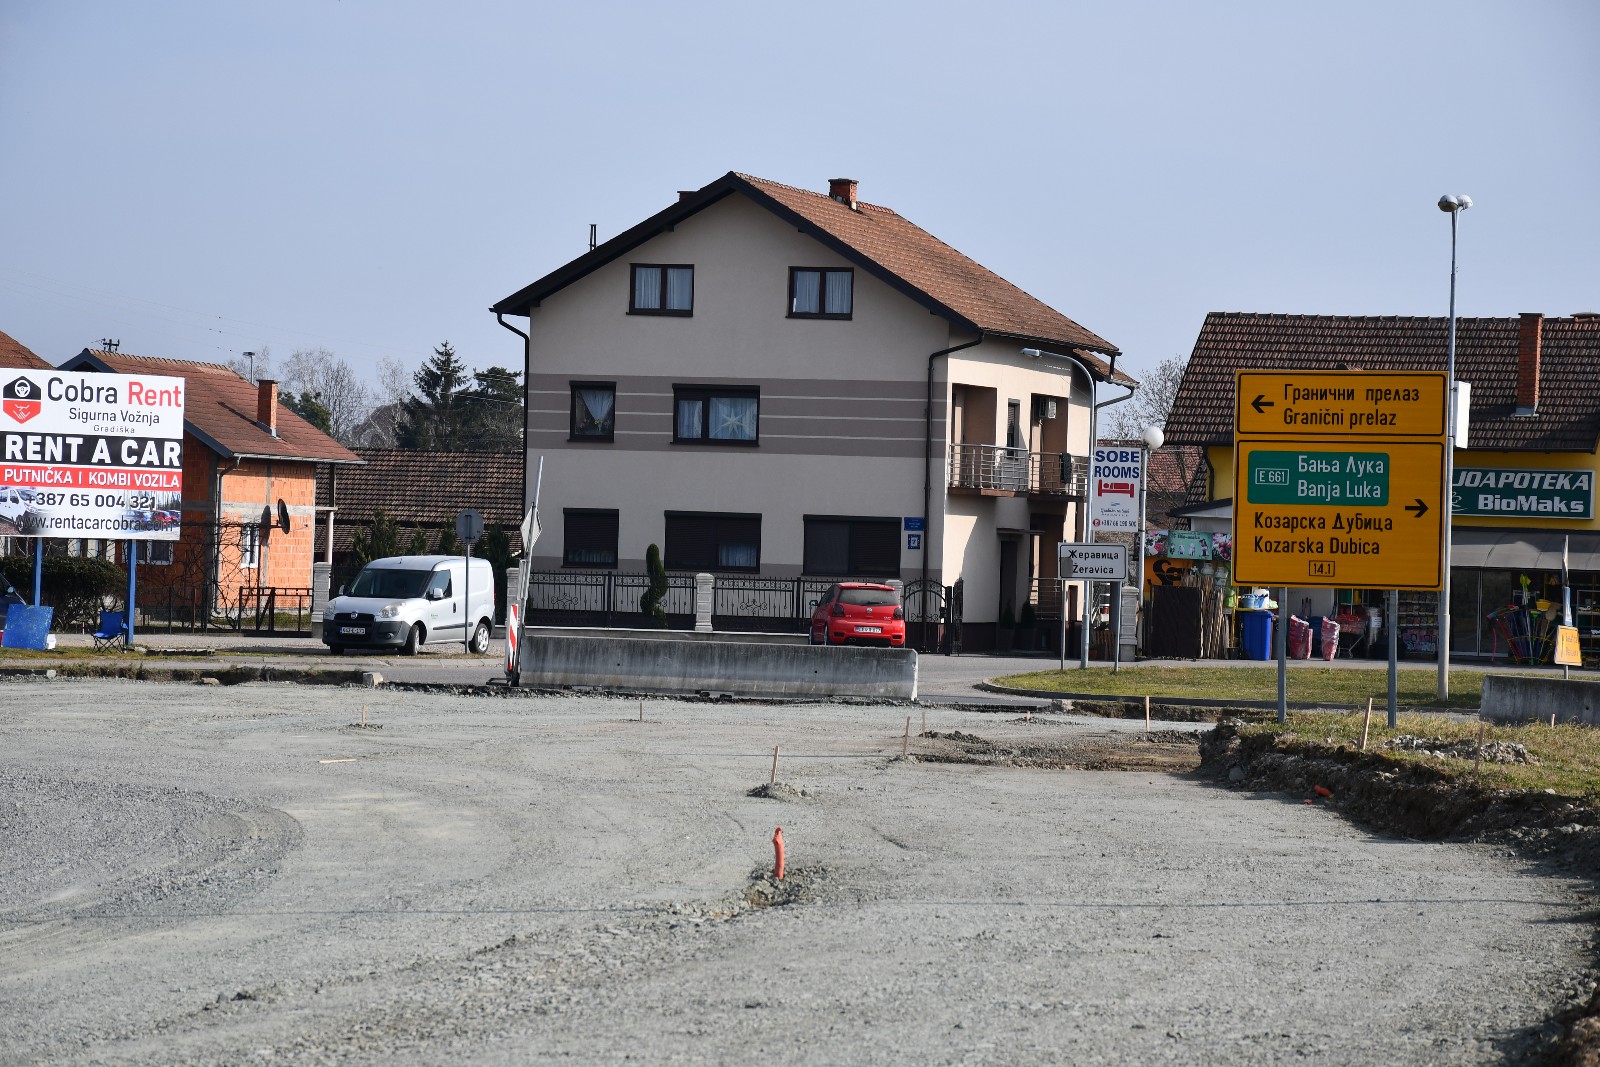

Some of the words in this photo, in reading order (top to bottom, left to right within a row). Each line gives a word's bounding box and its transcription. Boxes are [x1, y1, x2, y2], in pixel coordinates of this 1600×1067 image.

[47, 377, 118, 404] Cobra
[128, 381, 182, 407] Rent
[1284, 383, 1355, 405] Гранични
[1365, 388, 1420, 405] прелаз
[69, 407, 117, 423] Sigurna
[120, 409, 160, 426] Vožnja
[1283, 408, 1344, 425] Granični
[1350, 409, 1397, 429] prelaz
[93, 424, 135, 434] Gradiška
[5, 434, 84, 463] RENT
[91, 438, 112, 464] A
[121, 439, 181, 467] CAR
[1095, 450, 1140, 463] SOBE
[1094, 466, 1140, 479] ROOMS
[1298, 455, 1340, 473] Бања
[1346, 456, 1384, 477] Лука
[4, 467, 73, 484] PUTNIČKA
[78, 471, 83, 485] I
[88, 472, 131, 486] KOMBI
[134, 474, 180, 488] VOZILA
[1259, 471, 1266, 482] E
[1268, 471, 1285, 483] 661
[1297, 480, 1340, 501] Banja
[1346, 481, 1381, 498] Luka
[27, 492, 65, 506] +387
[69, 494, 90, 507] 65
[95, 495, 126, 508] 004
[130, 496, 156, 509] 321
[1478, 494, 1585, 513] BioMaks
[11, 514, 173, 532] www.rentacarcobra.com
[1254, 512, 1326, 533] Козарска
[1332, 512, 1393, 534] Дубица
[1068, 549, 1119, 561] Жеравица
[1254, 536, 1324, 554] Kozarska
[1329, 537, 1380, 555] Dubica
[1072, 562, 1114, 574] Žeravica
[1313, 563, 1331, 575] 14.1
